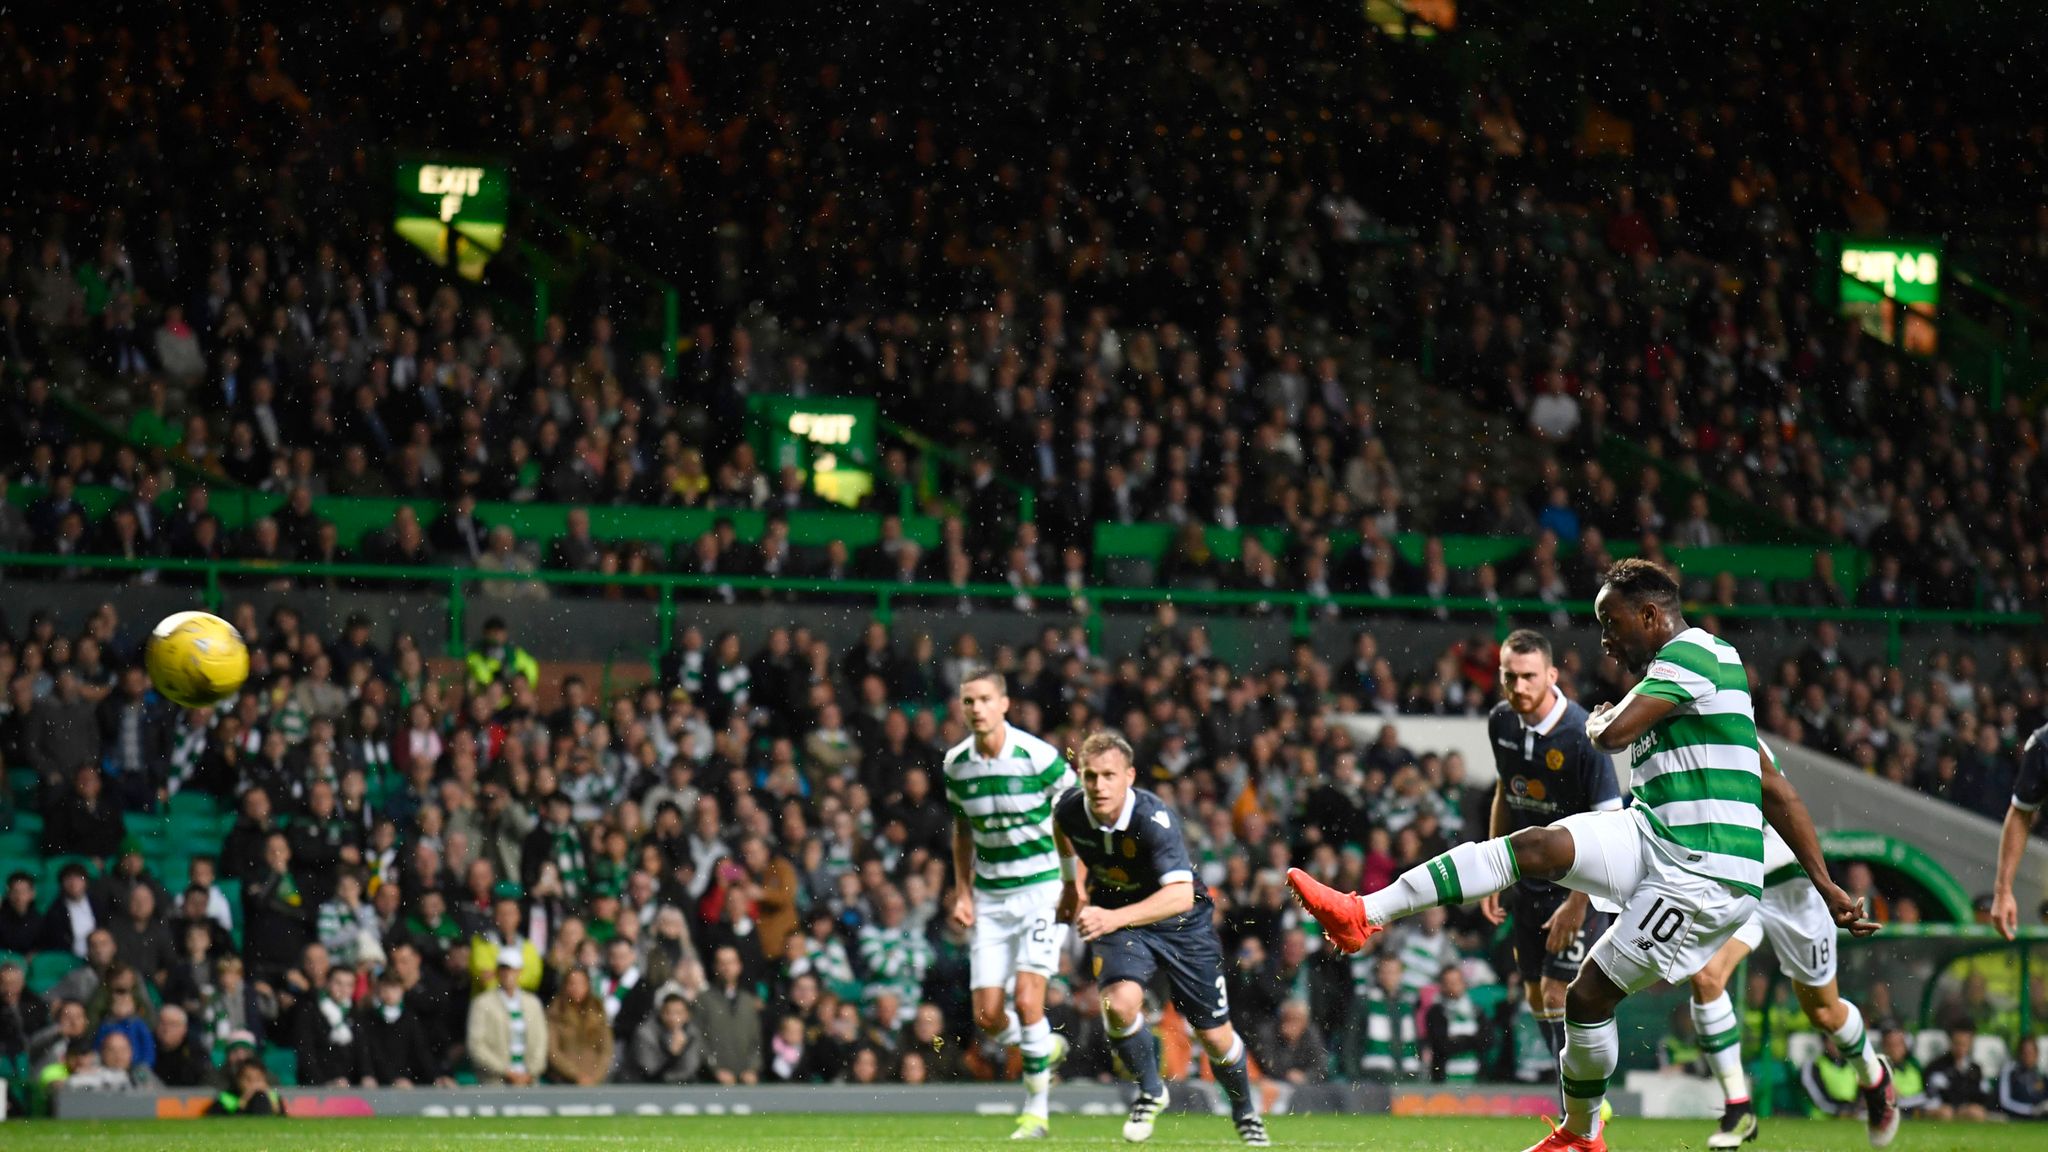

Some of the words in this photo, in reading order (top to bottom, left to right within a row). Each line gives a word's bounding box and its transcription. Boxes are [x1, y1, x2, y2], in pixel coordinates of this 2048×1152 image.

[418, 165, 485, 196] EXIT
[788, 412, 857, 444] EXIT
[1638, 896, 1684, 942] 10
[1812, 937, 1829, 969] 18
[1215, 974, 1228, 1008] 3
